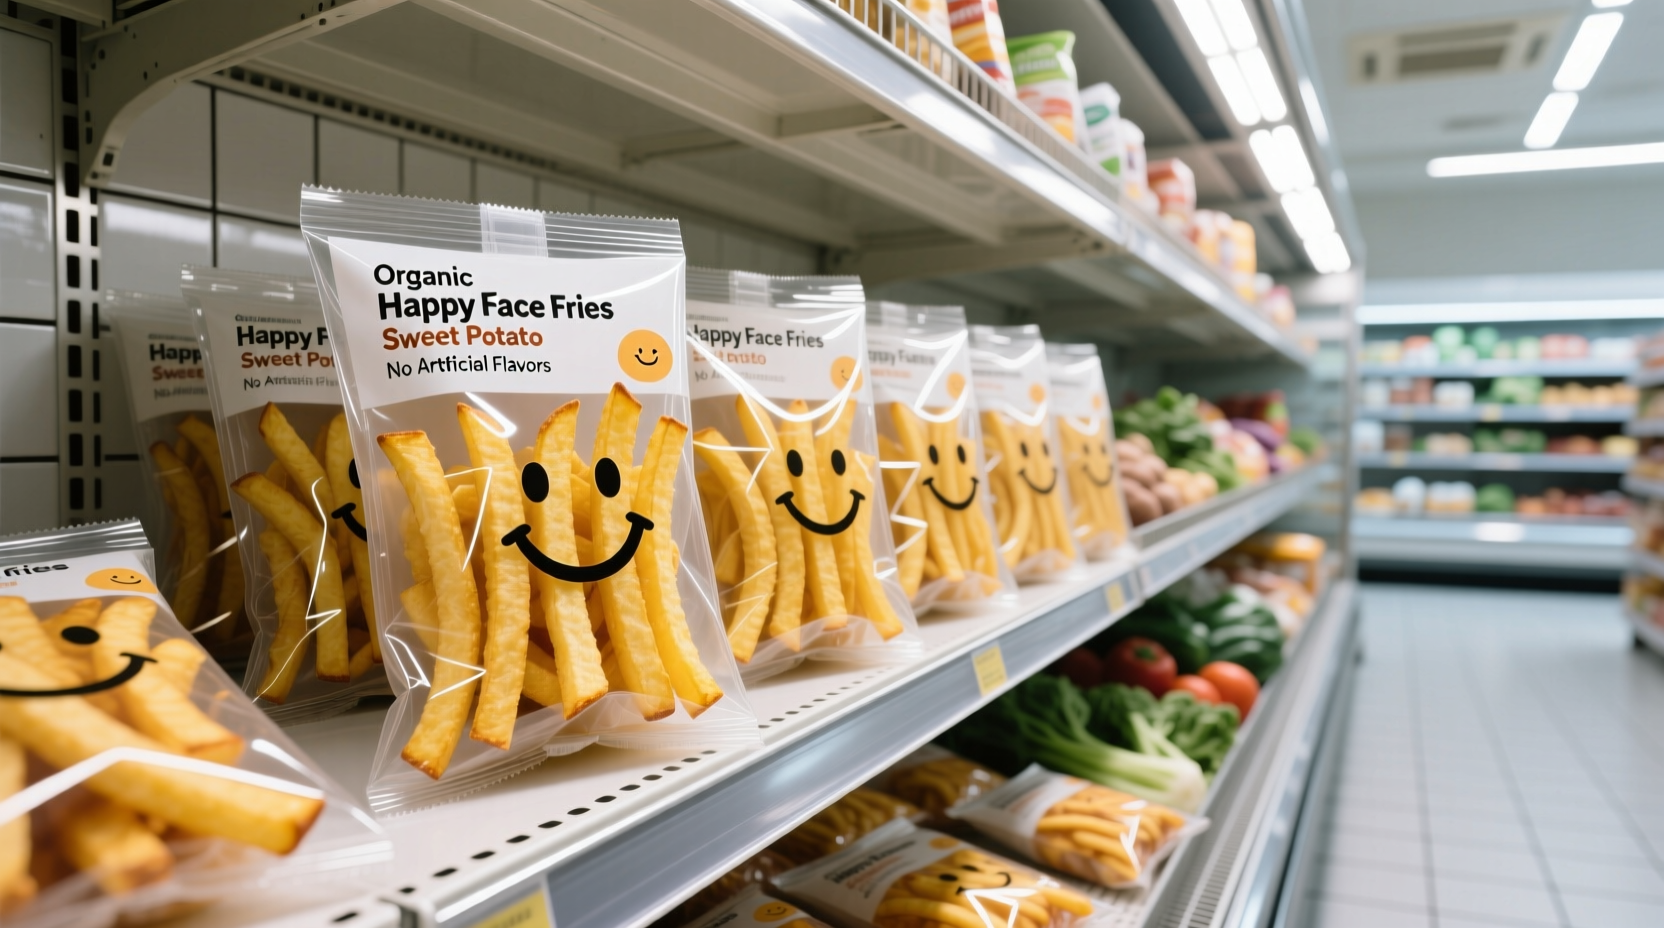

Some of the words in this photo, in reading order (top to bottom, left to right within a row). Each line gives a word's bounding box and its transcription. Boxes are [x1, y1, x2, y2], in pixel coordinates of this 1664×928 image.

[374, 264, 473, 291] Organic
[378, 292, 476, 324] Happy
[481, 291, 545, 318] Face
[550, 293, 614, 320] Fries
[236, 325, 312, 351] Happy
[382, 326, 460, 350] Sweet
[466, 325, 543, 347] Potato
[745, 327, 783, 346] Face
[786, 330, 824, 349] Fries
[150, 343, 202, 365] Happ
[241, 351, 302, 369] Sweet
[386, 361, 412, 379] No
[493, 355, 552, 373] Flavors
[243, 376, 261, 391] No
